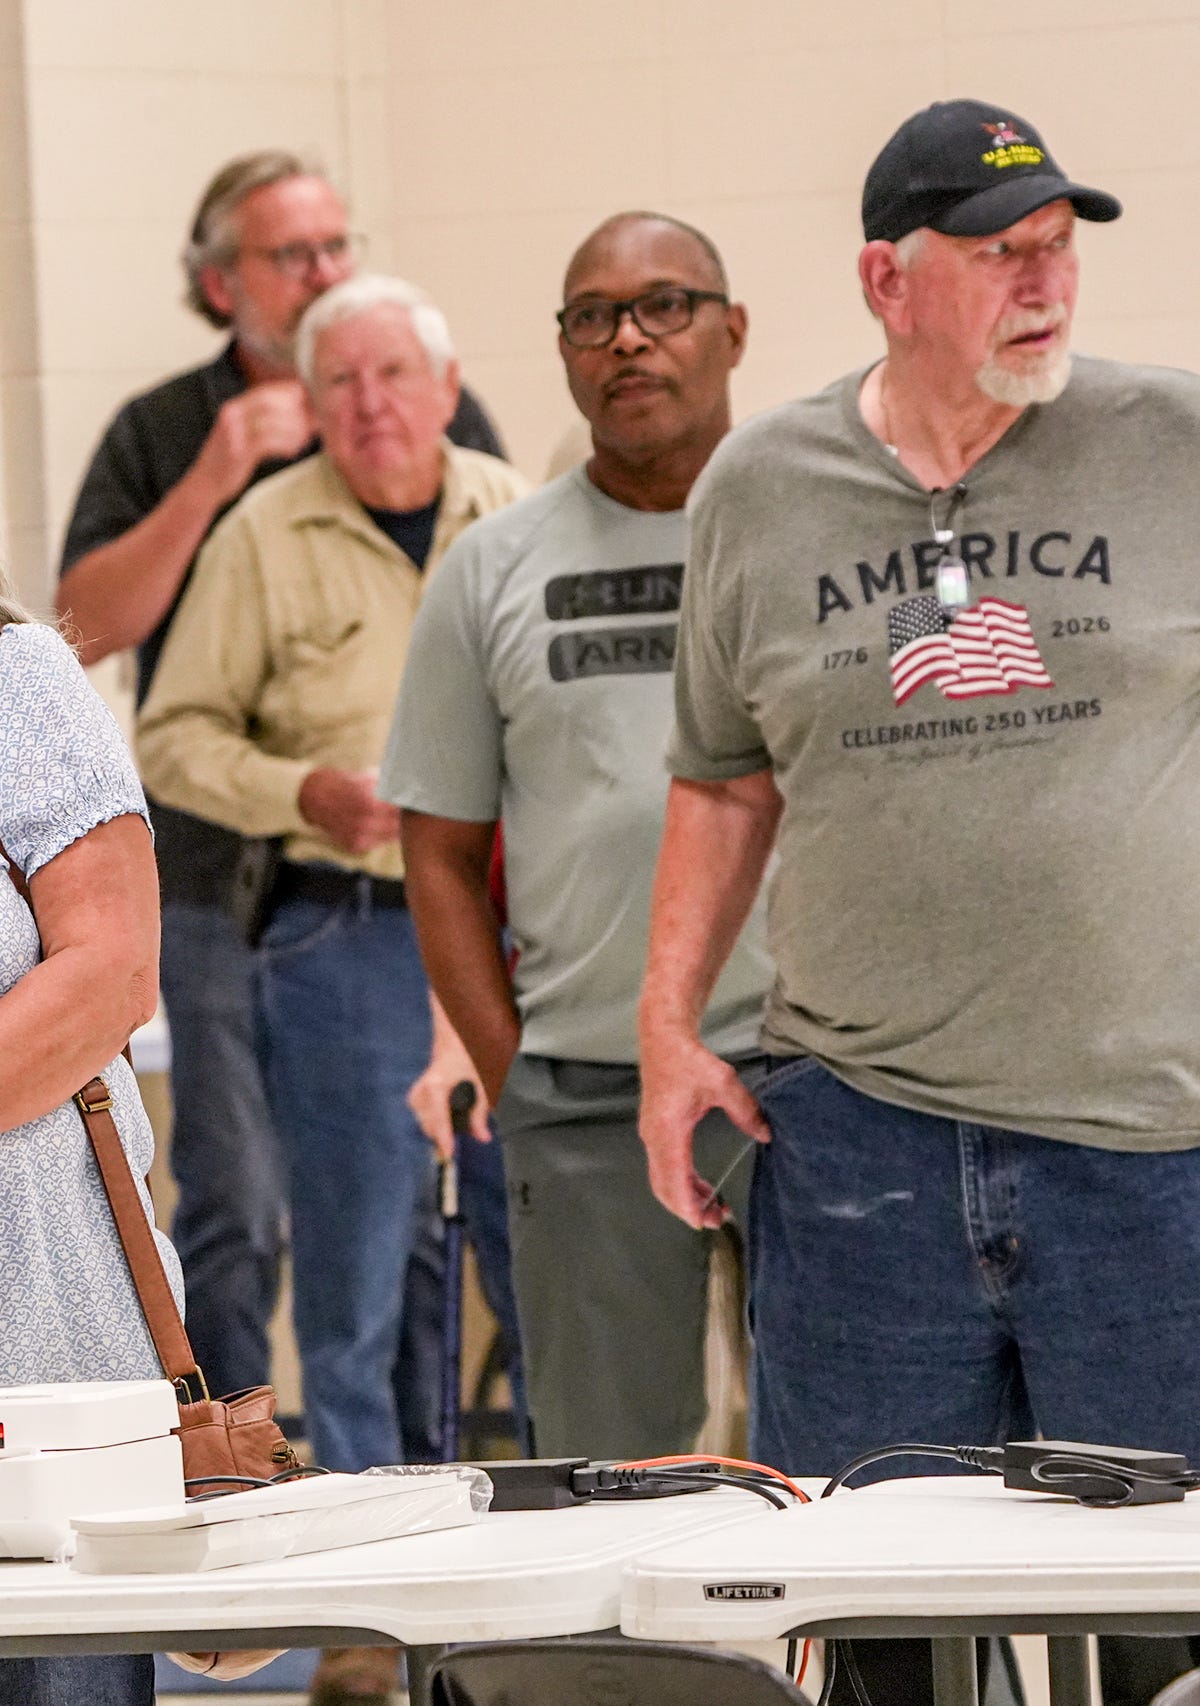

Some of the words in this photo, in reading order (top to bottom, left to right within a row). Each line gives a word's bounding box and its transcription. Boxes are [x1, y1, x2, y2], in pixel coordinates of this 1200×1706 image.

[1011, 145, 1045, 158] NAVY
[816, 530, 1112, 624] AMERICA
[1052, 616, 1111, 638] 2026
[823, 645, 868, 671] 1776
[842, 714, 979, 749] CELEBRATING
[985, 709, 1026, 733] 250
[1033, 698, 1102, 726] YEARS
[713, 1586, 775, 1599] LIFETIME
